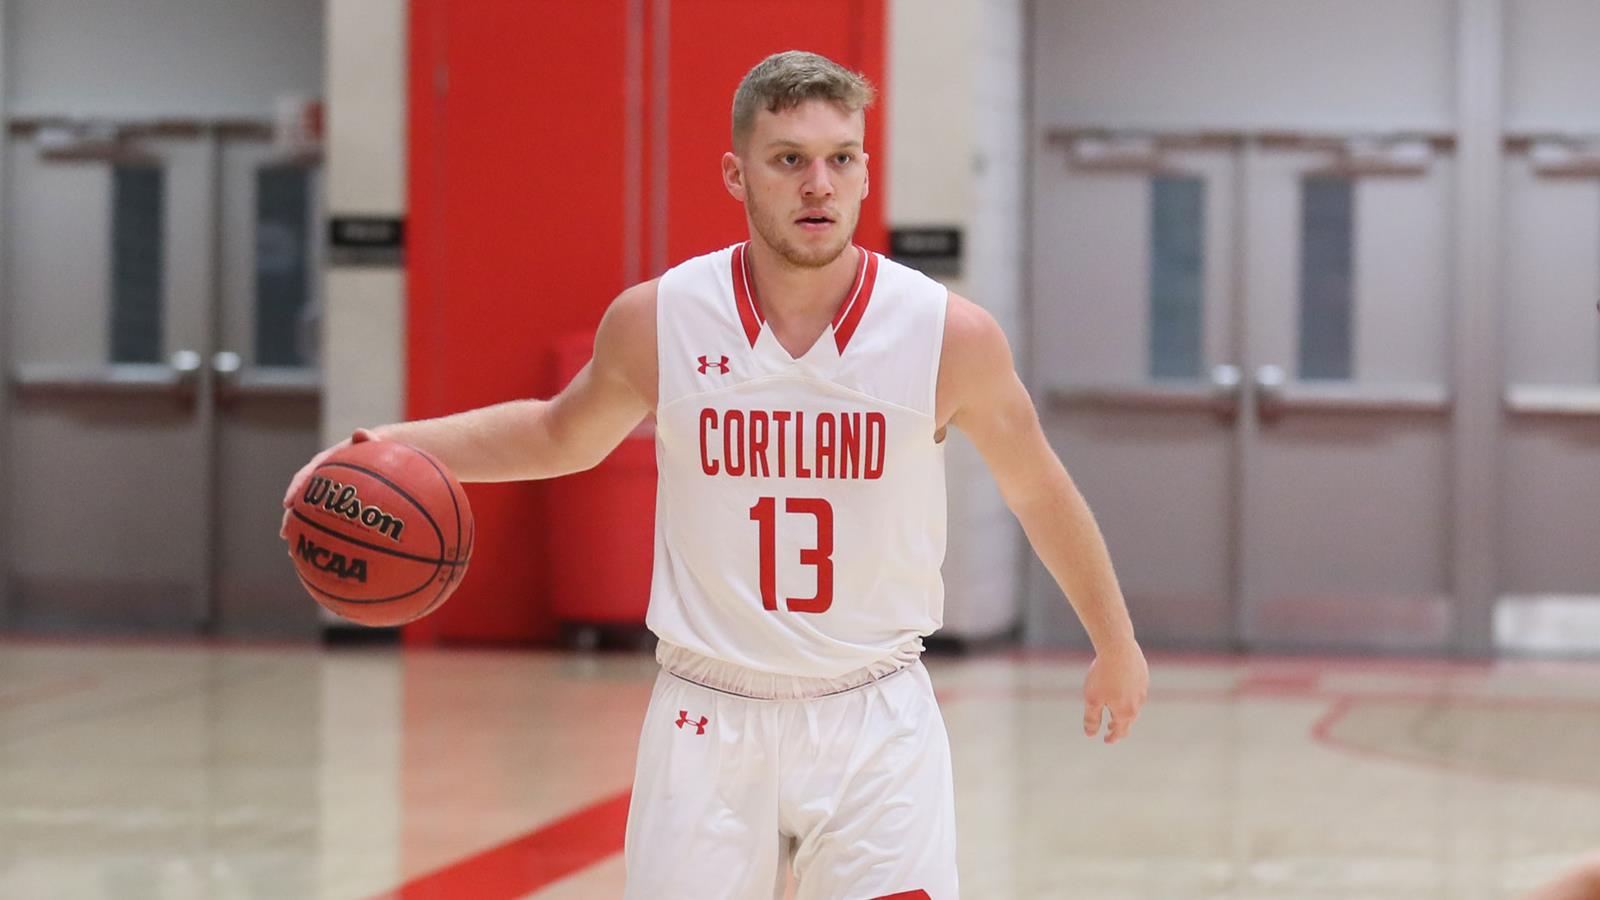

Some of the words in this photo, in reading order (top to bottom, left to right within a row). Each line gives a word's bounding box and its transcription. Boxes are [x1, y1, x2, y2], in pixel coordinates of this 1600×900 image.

[700, 408, 886, 479] CORTLAND
[304, 475, 404, 543] Wilson
[297, 533, 367, 583] NCAA
[750, 497, 834, 614] 13
